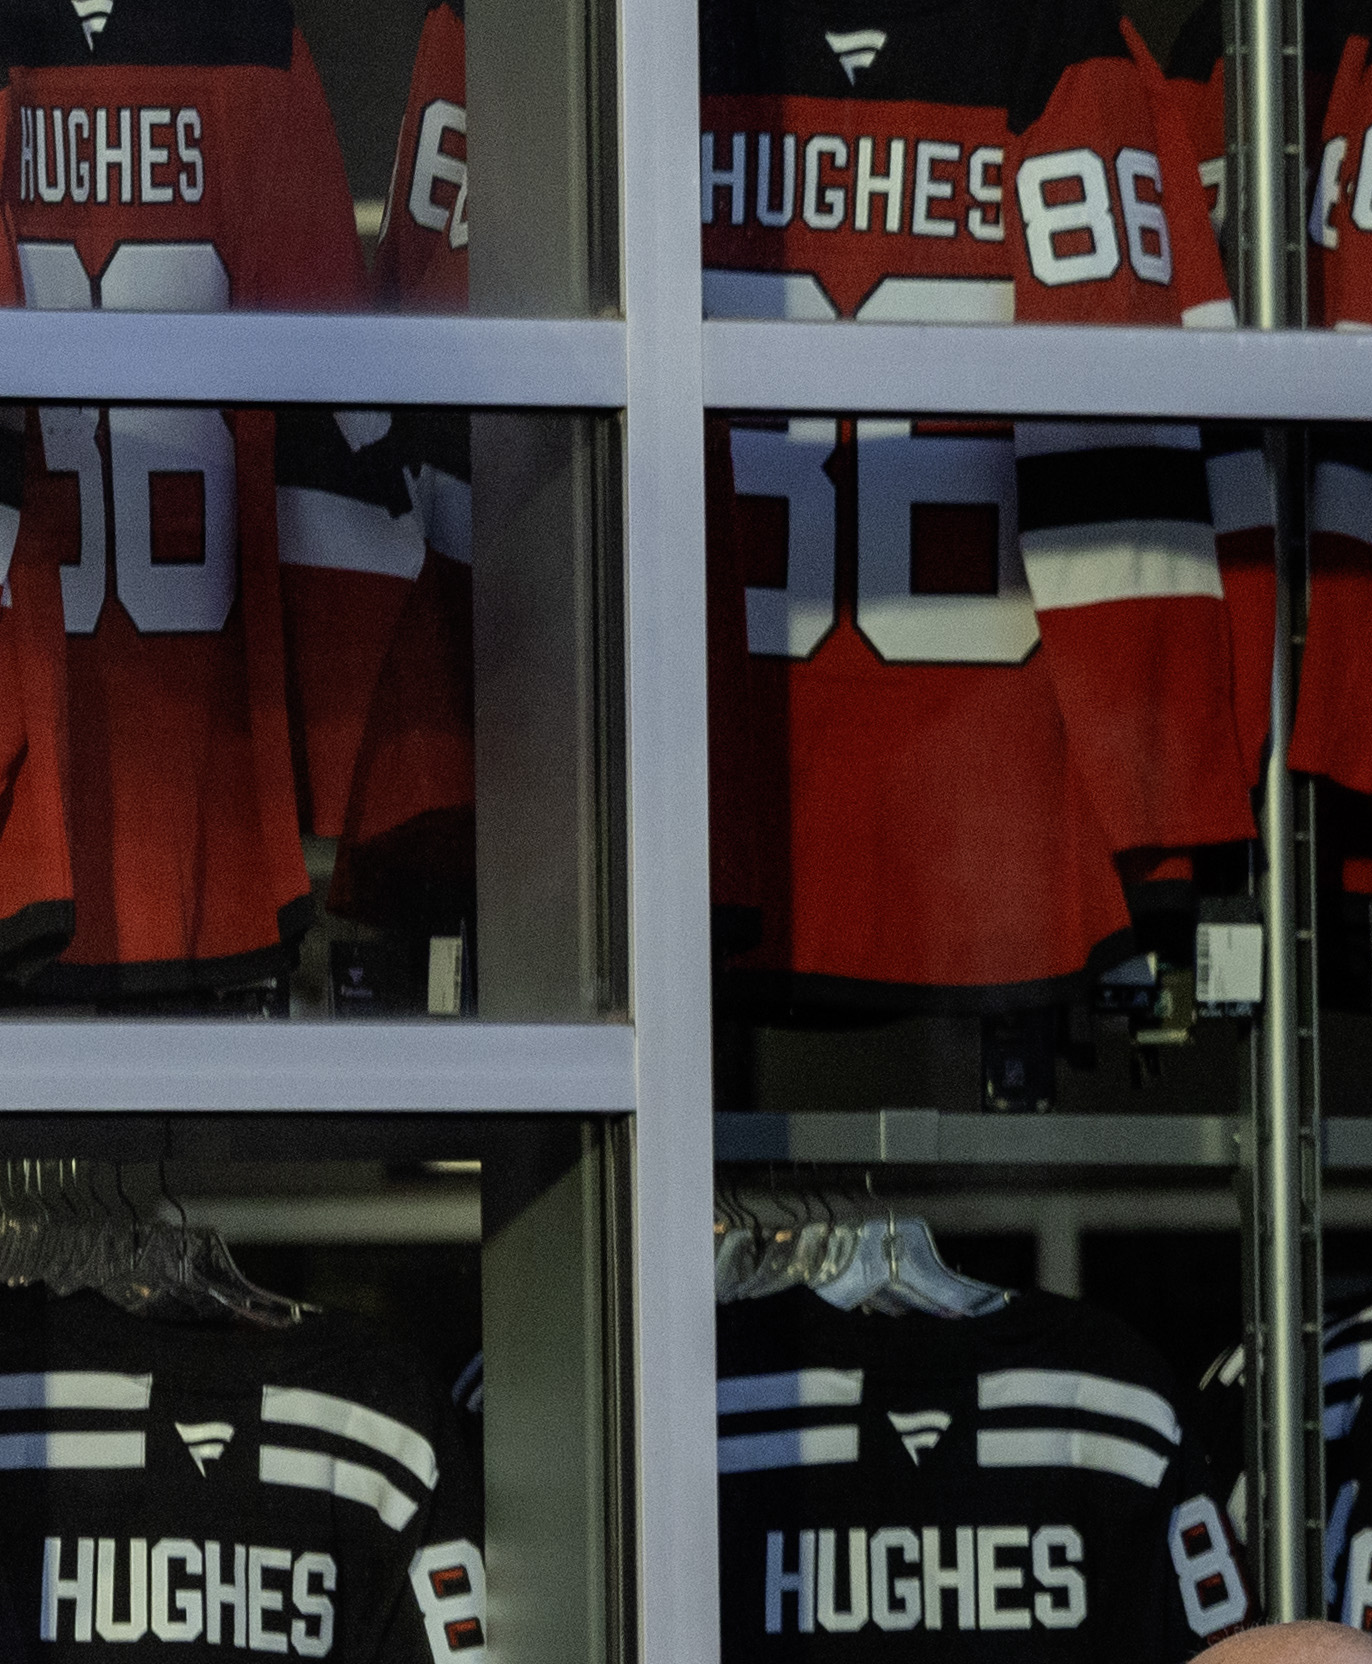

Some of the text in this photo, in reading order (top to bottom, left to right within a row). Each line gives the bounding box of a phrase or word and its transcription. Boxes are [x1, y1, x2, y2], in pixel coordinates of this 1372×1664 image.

[20, 106, 205, 204] HUGHES
[702, 131, 1004, 242] HUGHES
[1016, 147, 1173, 287] 86
[40, 1537, 337, 1658] HUGHES
[765, 1525, 1088, 1634] HUGHES
[1168, 1494, 1249, 1637] 8
